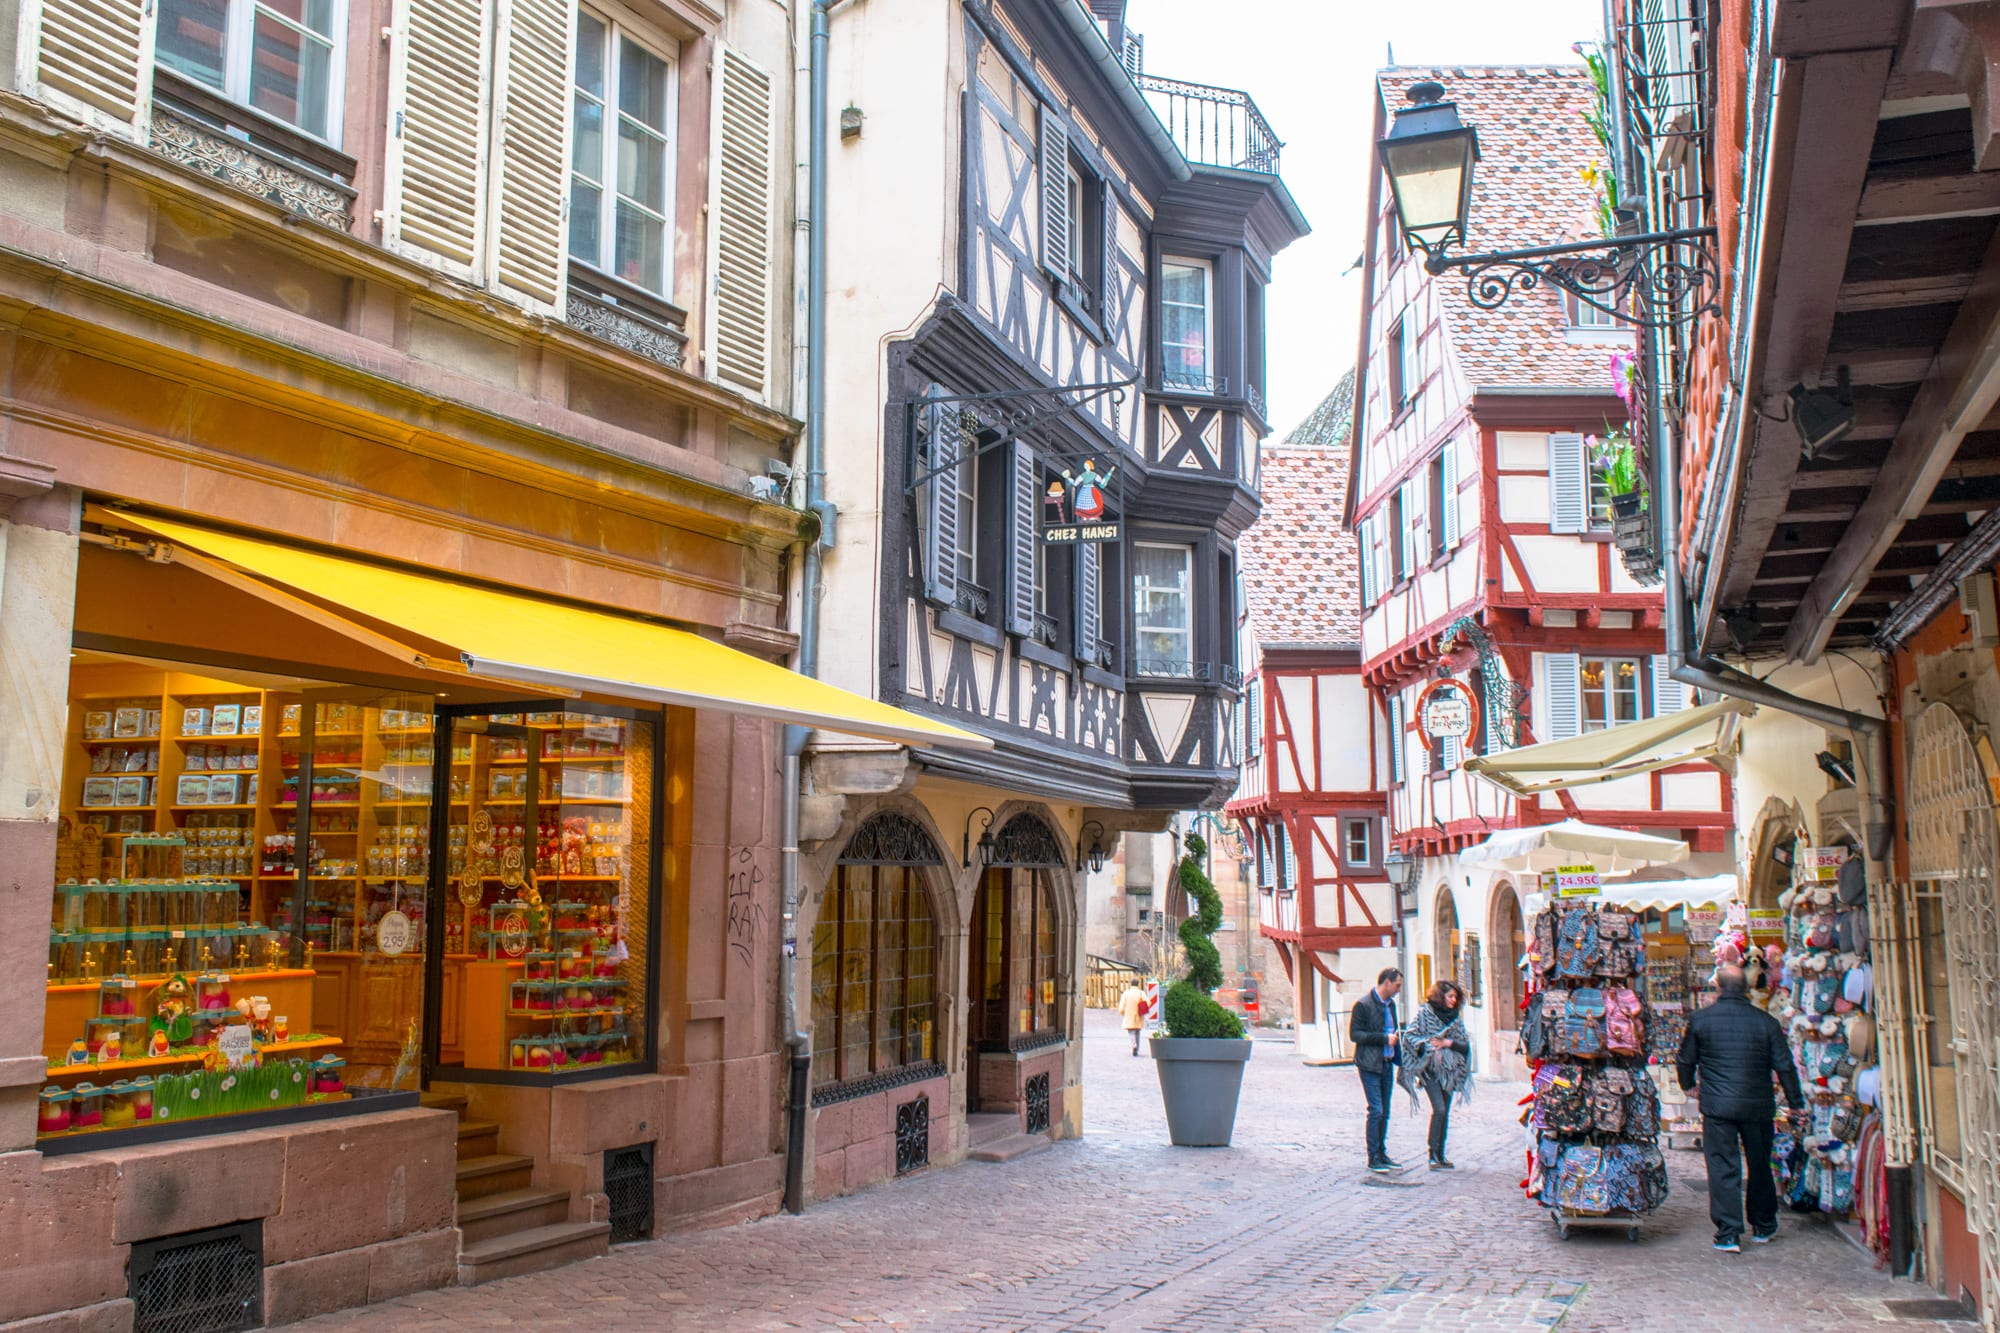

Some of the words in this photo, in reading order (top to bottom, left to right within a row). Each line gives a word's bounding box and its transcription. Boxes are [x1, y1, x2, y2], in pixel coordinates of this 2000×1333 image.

[1046, 527, 1077, 541] CHEZ
[1082, 525, 1118, 539] HANSI
[1560, 875, 1599, 886] 24.95€
[1751, 919, 1784, 928] 19.95€
